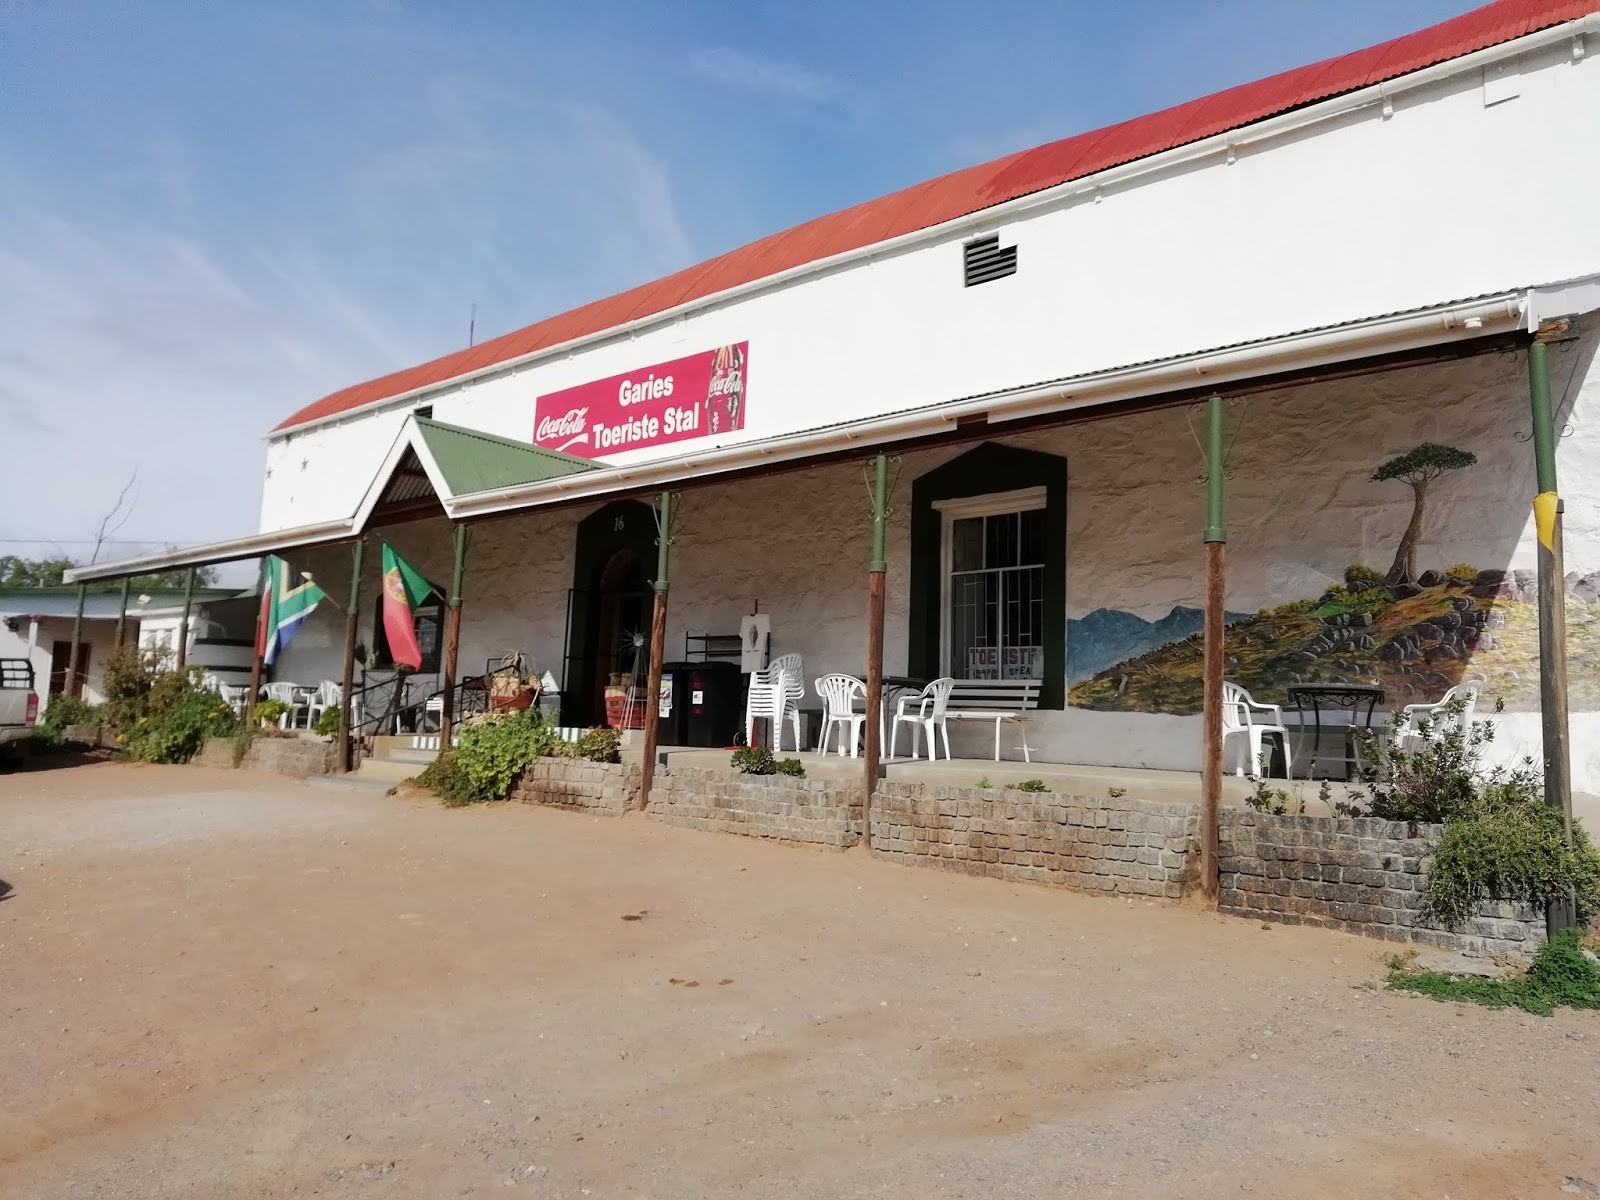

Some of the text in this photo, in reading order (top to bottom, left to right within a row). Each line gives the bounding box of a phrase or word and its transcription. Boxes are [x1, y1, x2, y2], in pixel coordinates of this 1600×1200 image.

[619, 374, 673, 406] Garies
[593, 402, 699, 449] Toeriste Stal
[614, 515, 624, 531] 16
